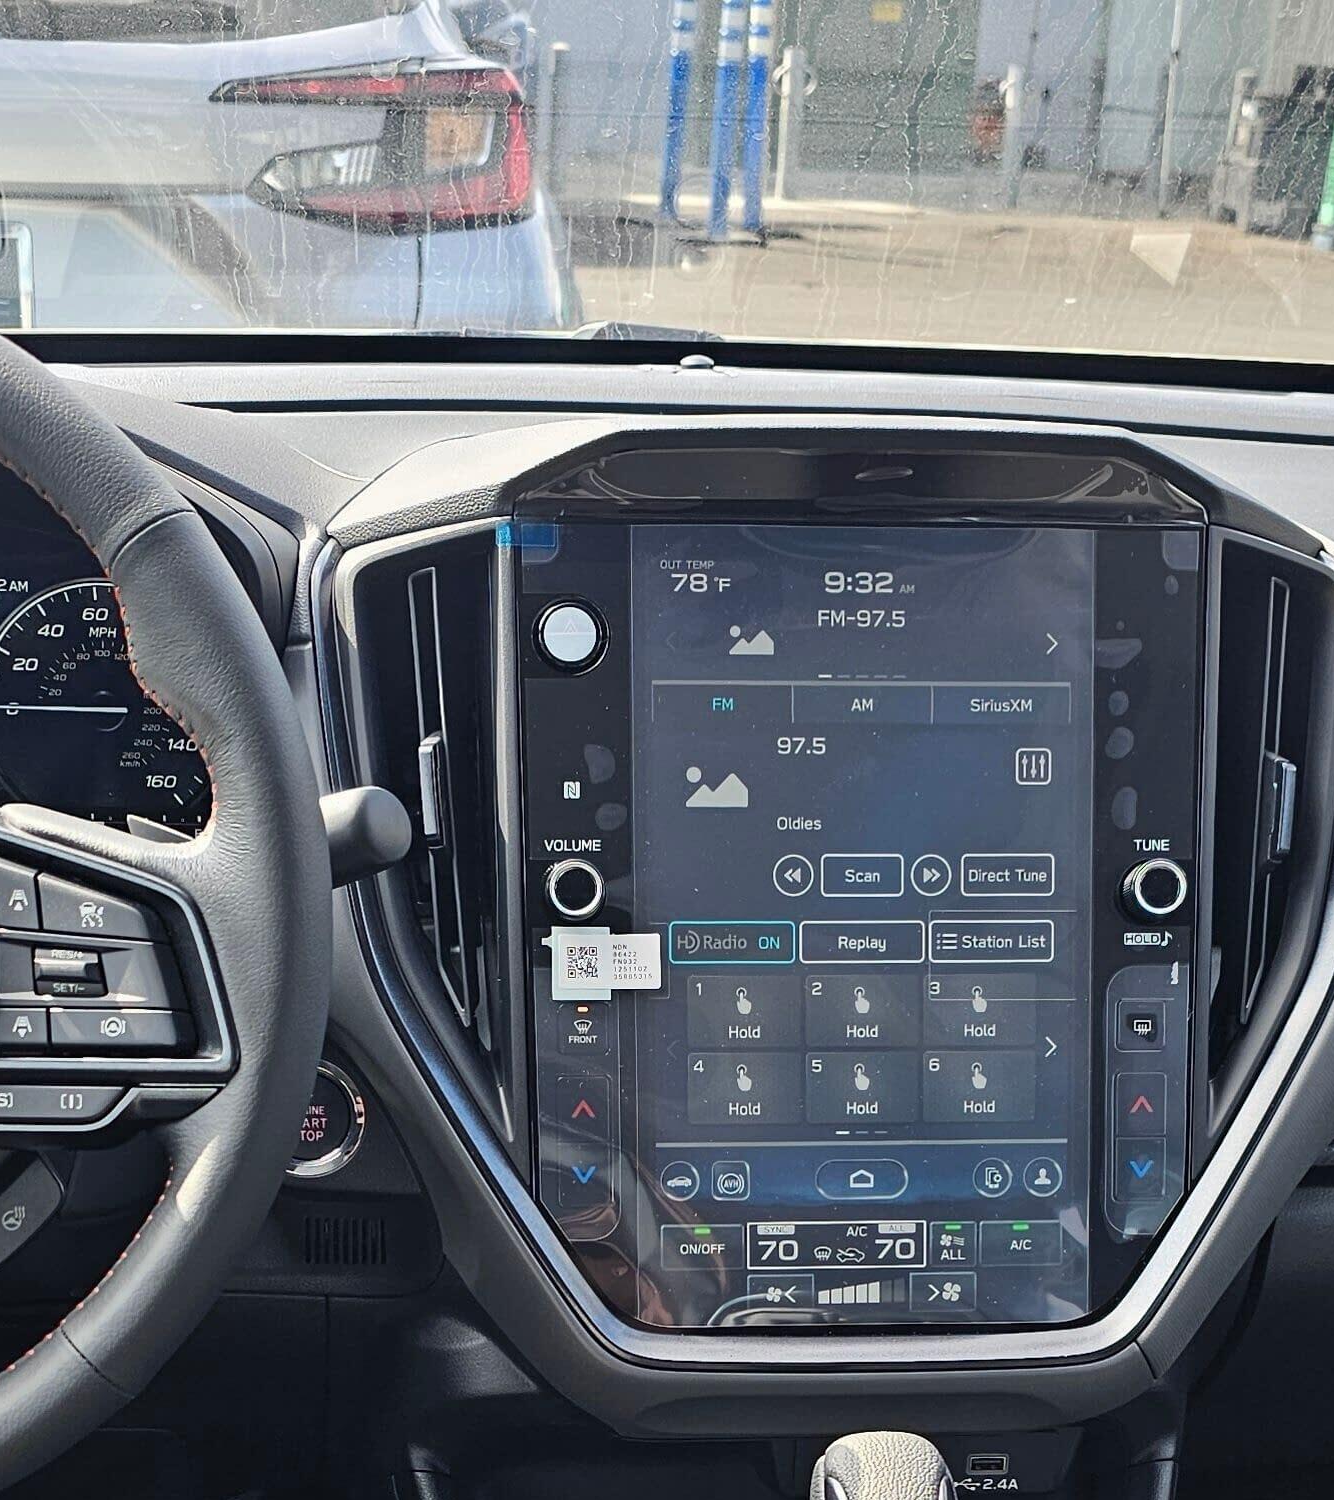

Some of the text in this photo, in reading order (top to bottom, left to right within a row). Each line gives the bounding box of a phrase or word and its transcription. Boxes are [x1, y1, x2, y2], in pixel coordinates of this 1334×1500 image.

[660, 560, 715, 570] OUT TEMP
[824, 571, 915, 594] 9:32 AM
[82, 608, 109, 621] 60
[817, 610, 906, 628] FM-97.5
[37, 625, 64, 638] 40
[89, 627, 117, 638] MPH
[76, 652, 90, 660] 80
[114, 653, 130, 661] 120
[12, 659, 38, 671] 20
[63, 662, 76, 670] 60
[143, 707, 162, 715] 200
[712, 698, 734, 711] FM
[851, 699, 874, 712] AM
[970, 699, 1033, 712] SiriusXM
[141, 724, 161, 732] 220
[133, 739, 153, 747] 240
[167, 738, 198, 751] 140
[777, 737, 826, 755] 97.5
[122, 752, 141, 760] 260
[120, 759, 141, 769] km/h
[145, 775, 177, 788] 160
[776, 816, 822, 831] Oldies
[544, 839, 602, 852] VOLUME
[1133, 839, 1170, 852] TUNE
[844, 869, 881, 884] Scan
[968, 868, 1048, 884] Direct Tune
[703, 934, 747, 951] Radio
[758, 936, 780, 950] ON
[838, 935, 886, 953] Replay
[961, 935, 1047, 949] Station List
[1125, 934, 1160, 945] HOLD
[695, 982, 703, 996] 1
[811, 982, 823, 996] 2
[929, 981, 941, 995] 3
[728, 1025, 761, 1040] Hold
[846, 1024, 879, 1039] Hold
[963, 1023, 996, 1038] Hold
[568, 1035, 598, 1044] FRONT
[693, 1060, 705, 1073] 4
[811, 1060, 823, 1073] 5
[928, 1058, 940, 1072] 6
[728, 1102, 761, 1116] Hold
[846, 1101, 879, 1116] Hold
[963, 1100, 996, 1115] Hold
[302, 1118, 328, 1129] ART
[300, 1130, 324, 1142] TOP
[723, 1178, 739, 1189] AVH
[763, 1226, 789, 1234] SYNC
[846, 1225, 868, 1238] A/C
[888, 1224, 906, 1233] ALL
[679, 1242, 726, 1256] ON/OFF
[757, 1239, 799, 1261] 70
[874, 1238, 916, 1260] 70
[1010, 1239, 1032, 1251] A/C
[940, 1248, 966, 1261] ALL
[982, 1479, 1019, 1490] 2.4A
